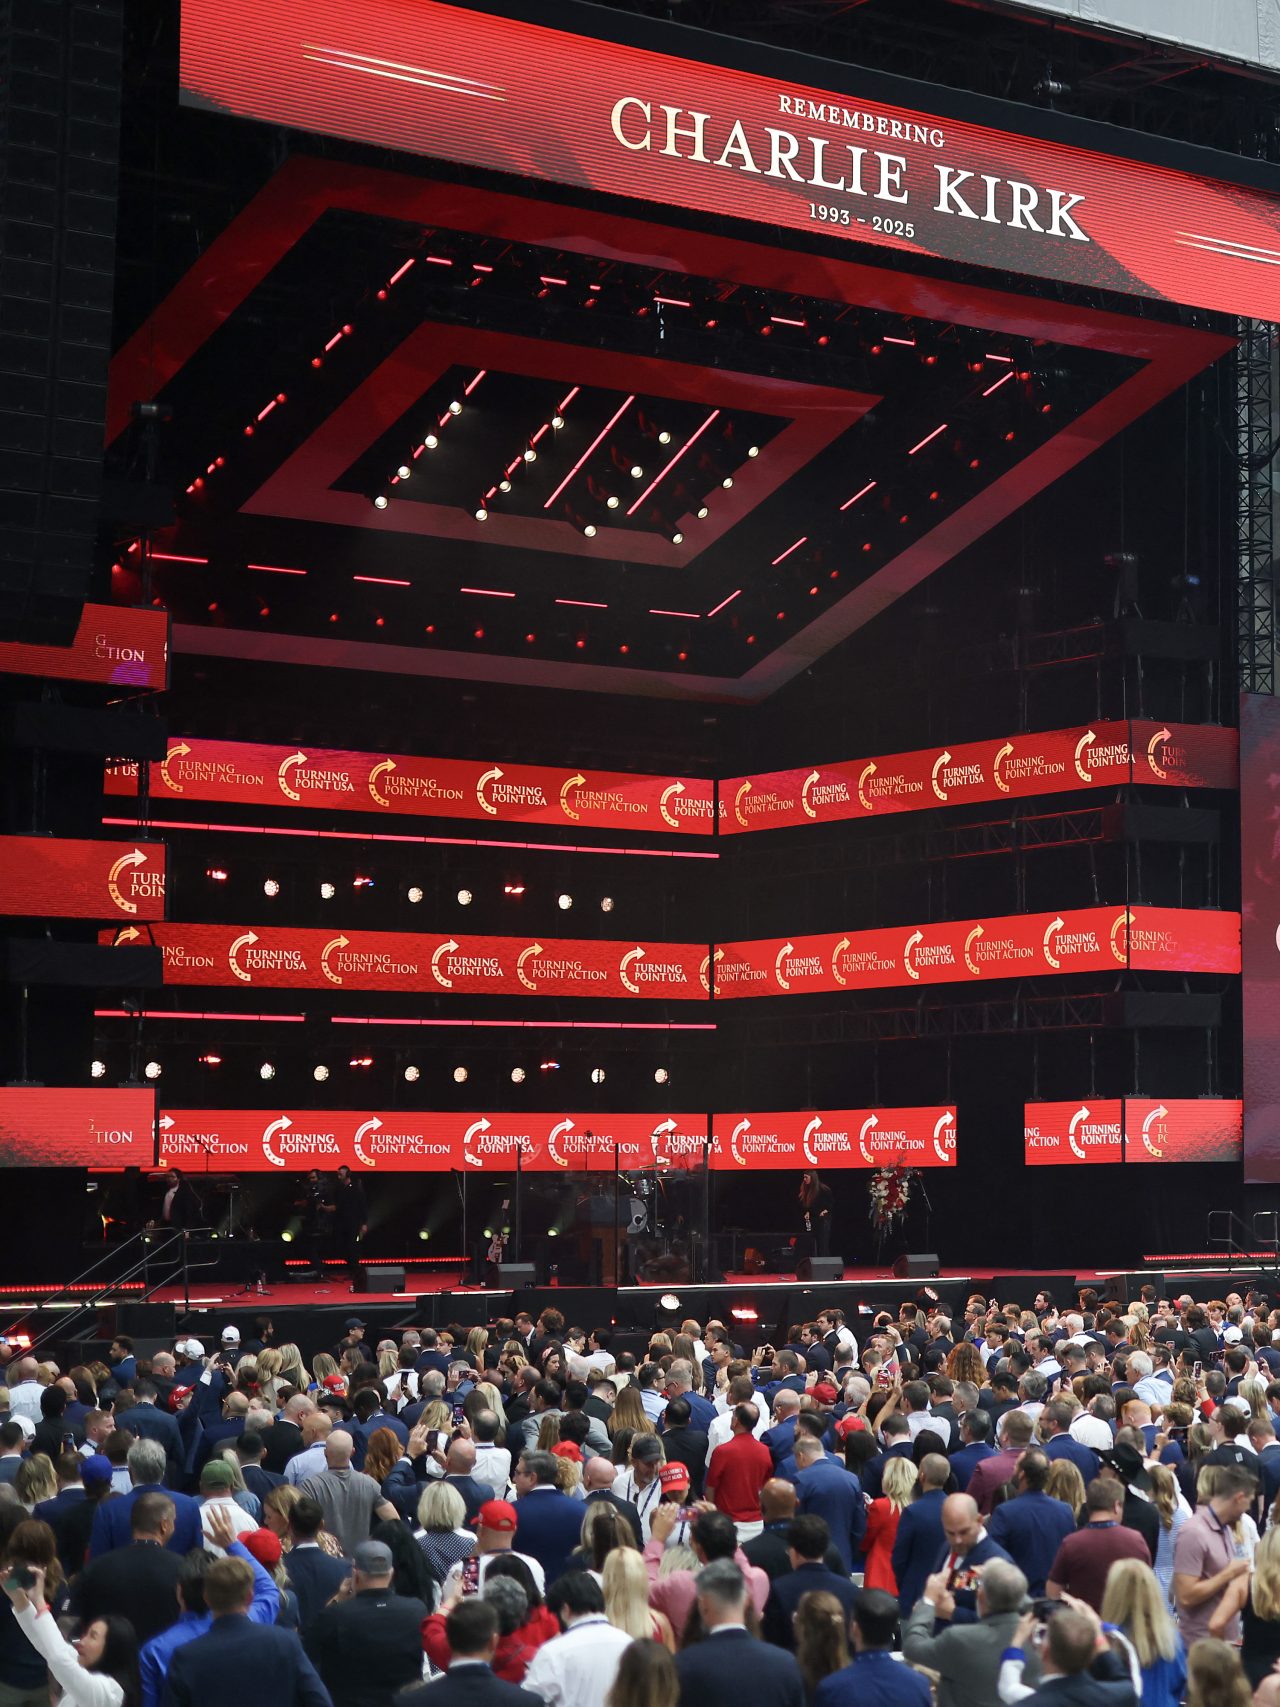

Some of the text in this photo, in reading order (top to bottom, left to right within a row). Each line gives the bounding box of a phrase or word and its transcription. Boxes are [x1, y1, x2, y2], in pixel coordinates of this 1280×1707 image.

[778, 94, 945, 148] REMEMBERING
[611, 97, 1091, 242] CHARLIE KIRK
[809, 203, 915, 238] 1993 2025
[1087, 744, 1128, 759] TURNING
[1005, 756, 1044, 770] TURNING
[1087, 754, 1136, 768] POINT USA
[178, 761, 235, 774] TURNING
[942, 764, 980, 778] TURNING
[1005, 763, 1065, 780] POINT ACTION
[178, 770, 264, 785] POINT ACTION
[295, 769, 349, 782] TURNING
[943, 773, 984, 788] POINT USA
[295, 779, 354, 792] POINT USA
[384, 776, 437, 788] TURNING
[869, 775, 904, 788] TURNING
[384, 786, 463, 799] POINT ACTION
[492, 784, 542, 796] TURNING
[812, 783, 846, 796] TURNING
[869, 782, 923, 797] POINT ACTION
[492, 793, 547, 806] POINT USA
[575, 790, 623, 802] TURNING
[744, 793, 777, 805] TURNING
[812, 792, 850, 805] POINT USA
[575, 800, 648, 813] POINT ACTION
[674, 798, 725, 809] TURNING
[744, 800, 794, 814] POINT ACTION
[675, 807, 705, 817] POINT
[1055, 932, 1095, 945] TURNING
[1122, 930, 1172, 941] TURNING
[915, 945, 951, 957] TURNING
[976, 940, 1013, 951] TURNING
[1055, 942, 1100, 955] POINT USA
[1123, 940, 1157, 951] POINT
[246, 949, 301, 960] TURNING
[337, 953, 391, 963] TURNING
[842, 952, 877, 963] TURNING
[976, 947, 1033, 961] POINT ACTION
[168, 956, 214, 967] ACTION
[246, 959, 307, 970] POINT USA
[447, 957, 498, 968] TURNING
[532, 960, 582, 971] TURNING
[786, 957, 820, 968] TURNING
[842, 959, 895, 973] POINT ACTION
[915, 955, 955, 967] POINT USA
[338, 962, 418, 974] POINT ACTION
[447, 966, 503, 977] POINT USA
[634, 963, 682, 974] TURNING
[717, 963, 750, 974] TURNING
[786, 965, 823, 977] POINT USA
[532, 969, 607, 980] POINT ACTION
[635, 973, 687, 983] POINT USA
[717, 970, 767, 982] POINT ACTION
[1081, 1124, 1120, 1134] TURNING
[162, 1134, 219, 1144] TURNING
[279, 1134, 334, 1144] TURNING
[370, 1135, 423, 1145] TURNING
[479, 1135, 530, 1145] TURNING
[563, 1136, 613, 1145] TURNING
[742, 1135, 777, 1144] TURNING
[814, 1133, 848, 1143] TURNING
[870, 1131, 906, 1141] TURNING
[1029, 1136, 1059, 1146] ACTION
[1081, 1133, 1129, 1144] POINT USA
[162, 1143, 248, 1154] POINT ACTION
[279, 1144, 340, 1154] POINT USA
[371, 1144, 450, 1154] POINT ACTION
[477, 1144, 511, 1153] POINT
[563, 1144, 596, 1153] POINT
[742, 1143, 795, 1153] POINT ACTION
[814, 1142, 851, 1151] POINT USA
[870, 1139, 924, 1150] POINT ACTION
